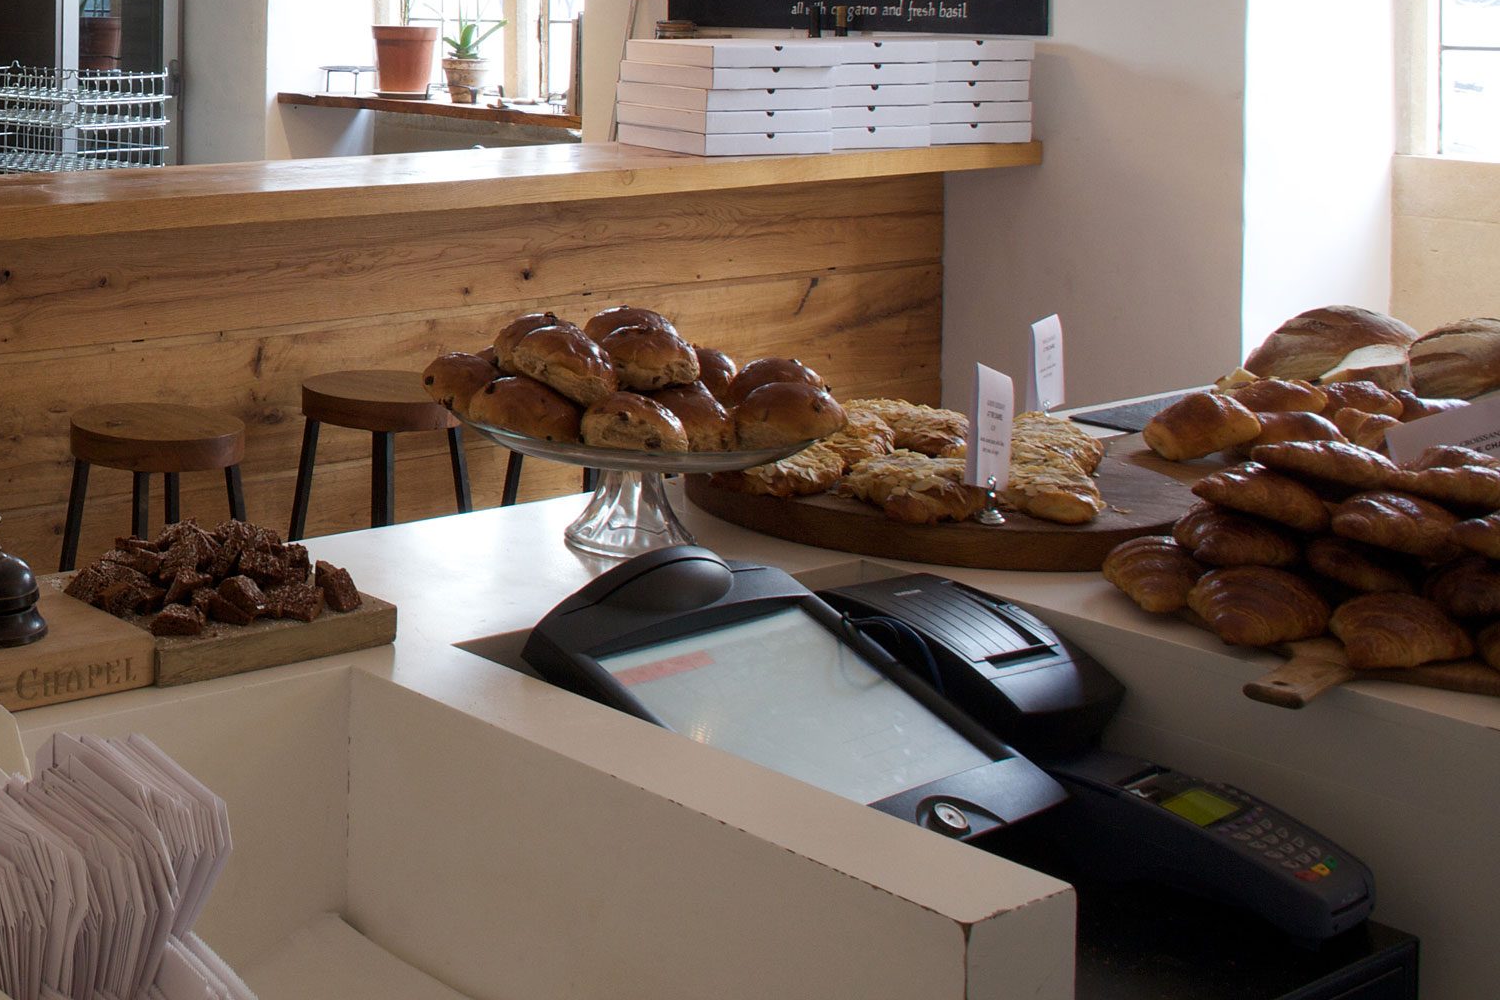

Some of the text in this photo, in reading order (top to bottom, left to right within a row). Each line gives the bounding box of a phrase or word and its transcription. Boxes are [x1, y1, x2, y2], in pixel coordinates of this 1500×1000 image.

[791, 2, 804, 15] all
[831, 5, 876, 22] ogano
[882, 0, 903, 16] and
[907, 1, 936, 22] fresh
[939, 1, 968, 19] basil
